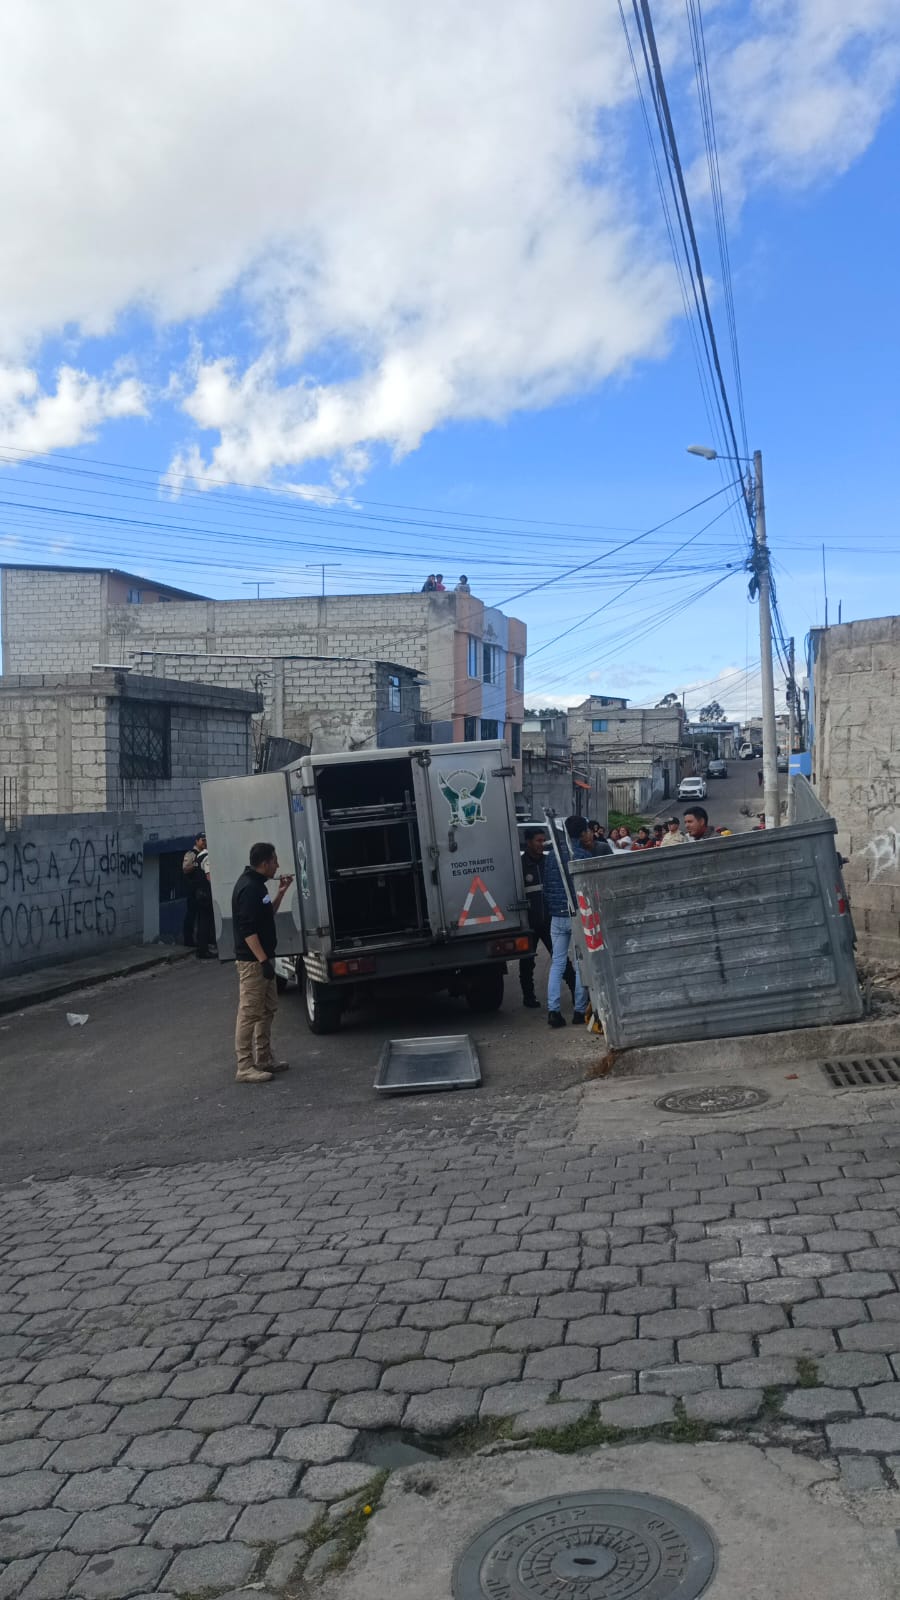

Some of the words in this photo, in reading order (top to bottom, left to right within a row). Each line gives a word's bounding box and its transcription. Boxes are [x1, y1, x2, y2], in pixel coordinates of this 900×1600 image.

[68, 838, 96, 887] 20
[451, 861, 468, 869] TODO
[462, 865, 494, 875] GRATUITO
